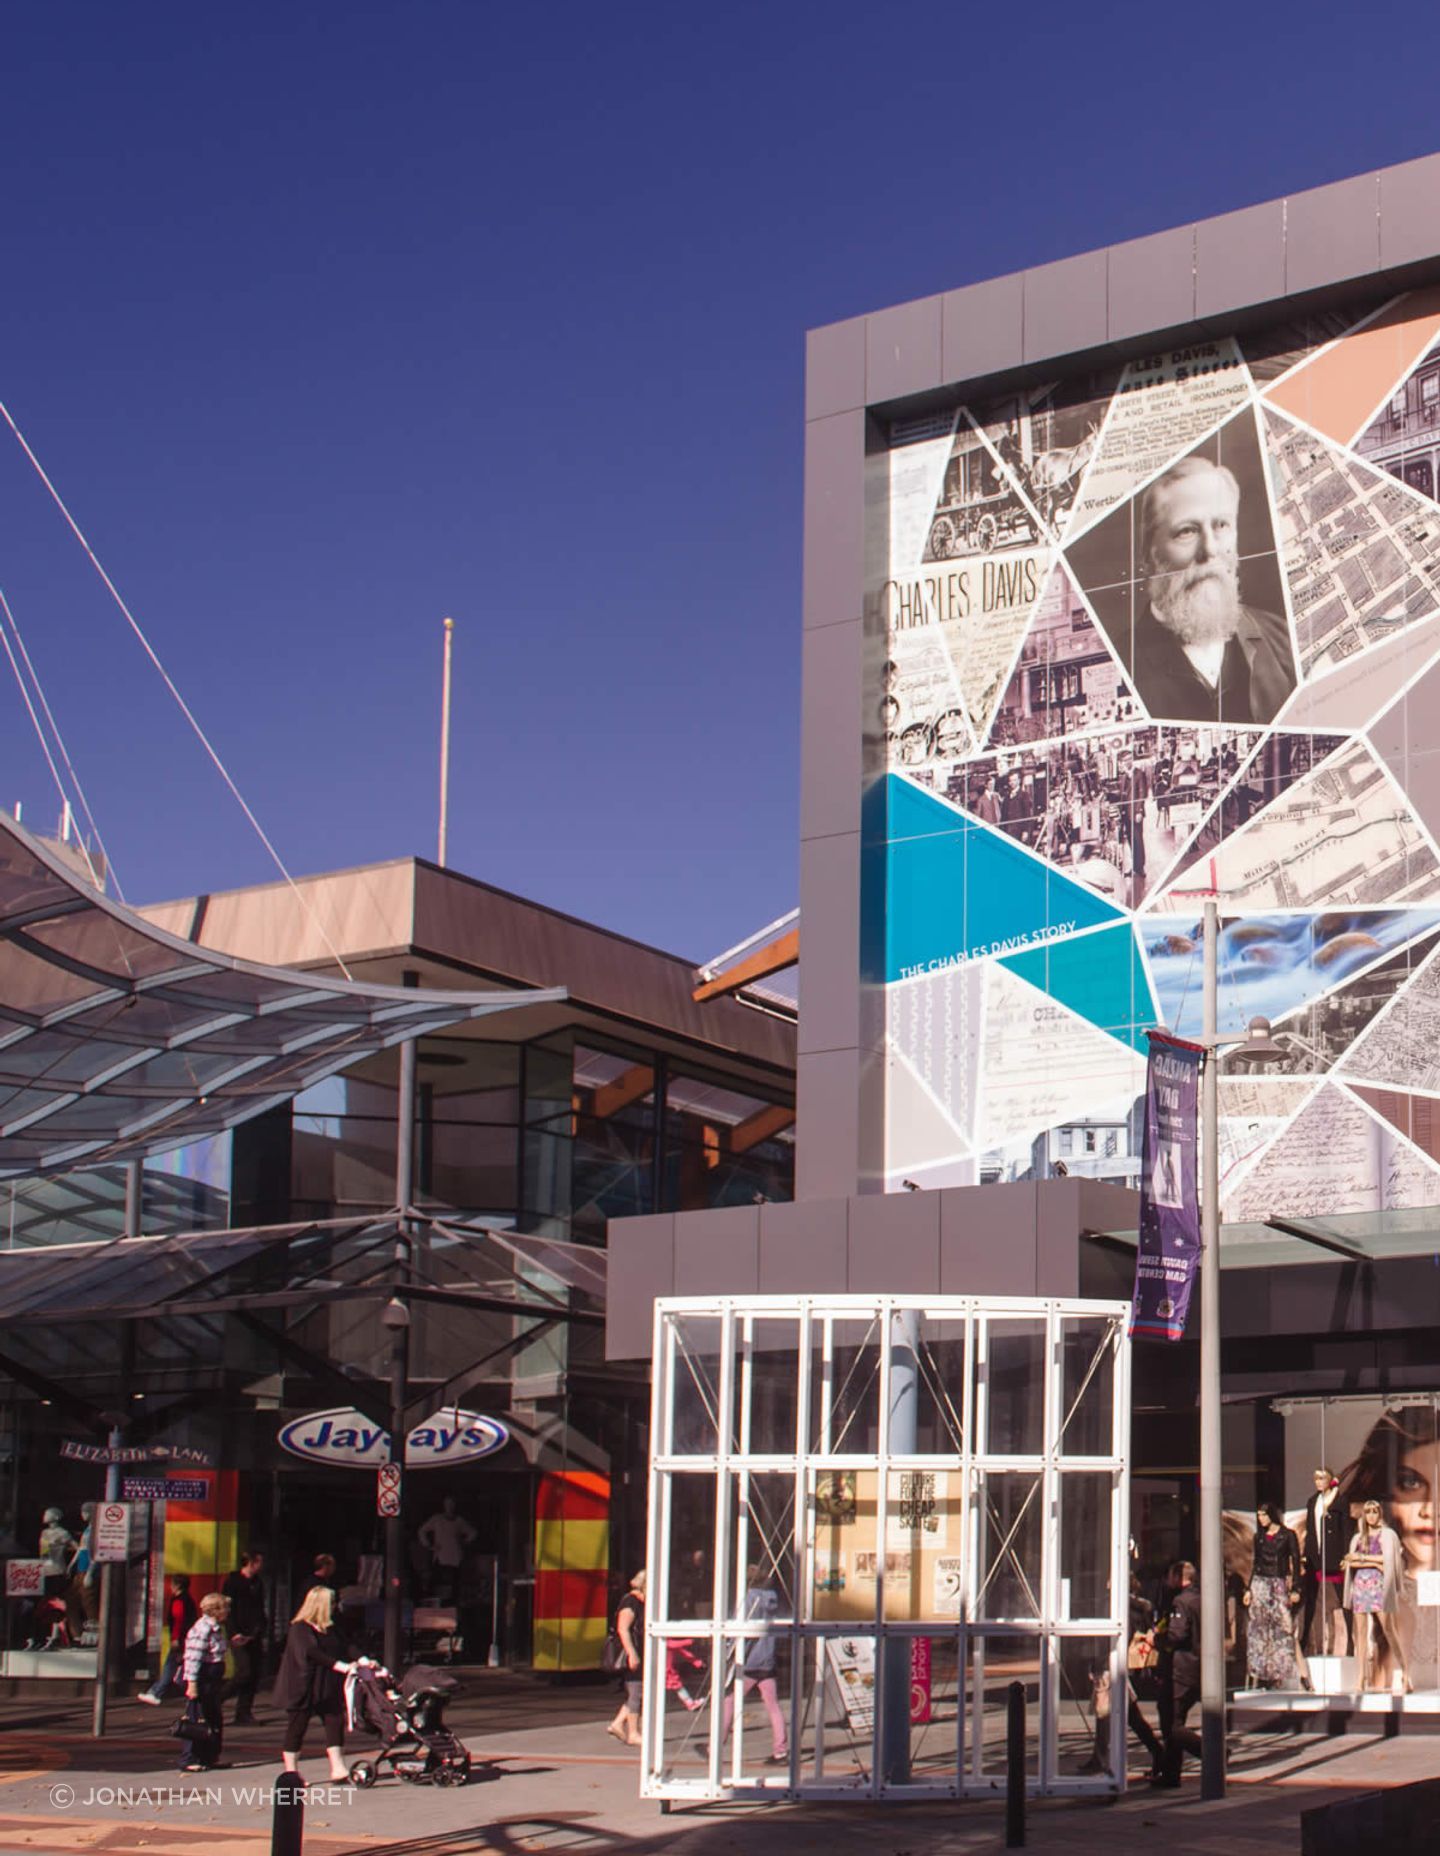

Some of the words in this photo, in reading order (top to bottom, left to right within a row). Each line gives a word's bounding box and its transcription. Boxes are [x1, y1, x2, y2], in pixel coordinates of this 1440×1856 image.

[881, 571, 971, 632] CHARLES
[982, 557, 1037, 613] DAVIS
[900, 962, 926, 980] THE
[928, 945, 989, 973] CHARLES
[991, 932, 1029, 955] DAVIS
[1031, 920, 1077, 942] STORY
[383, 1424, 485, 1453] ays
[900, 1473, 936, 1487] CULTURE
[900, 1500, 936, 1517] CHEAP
